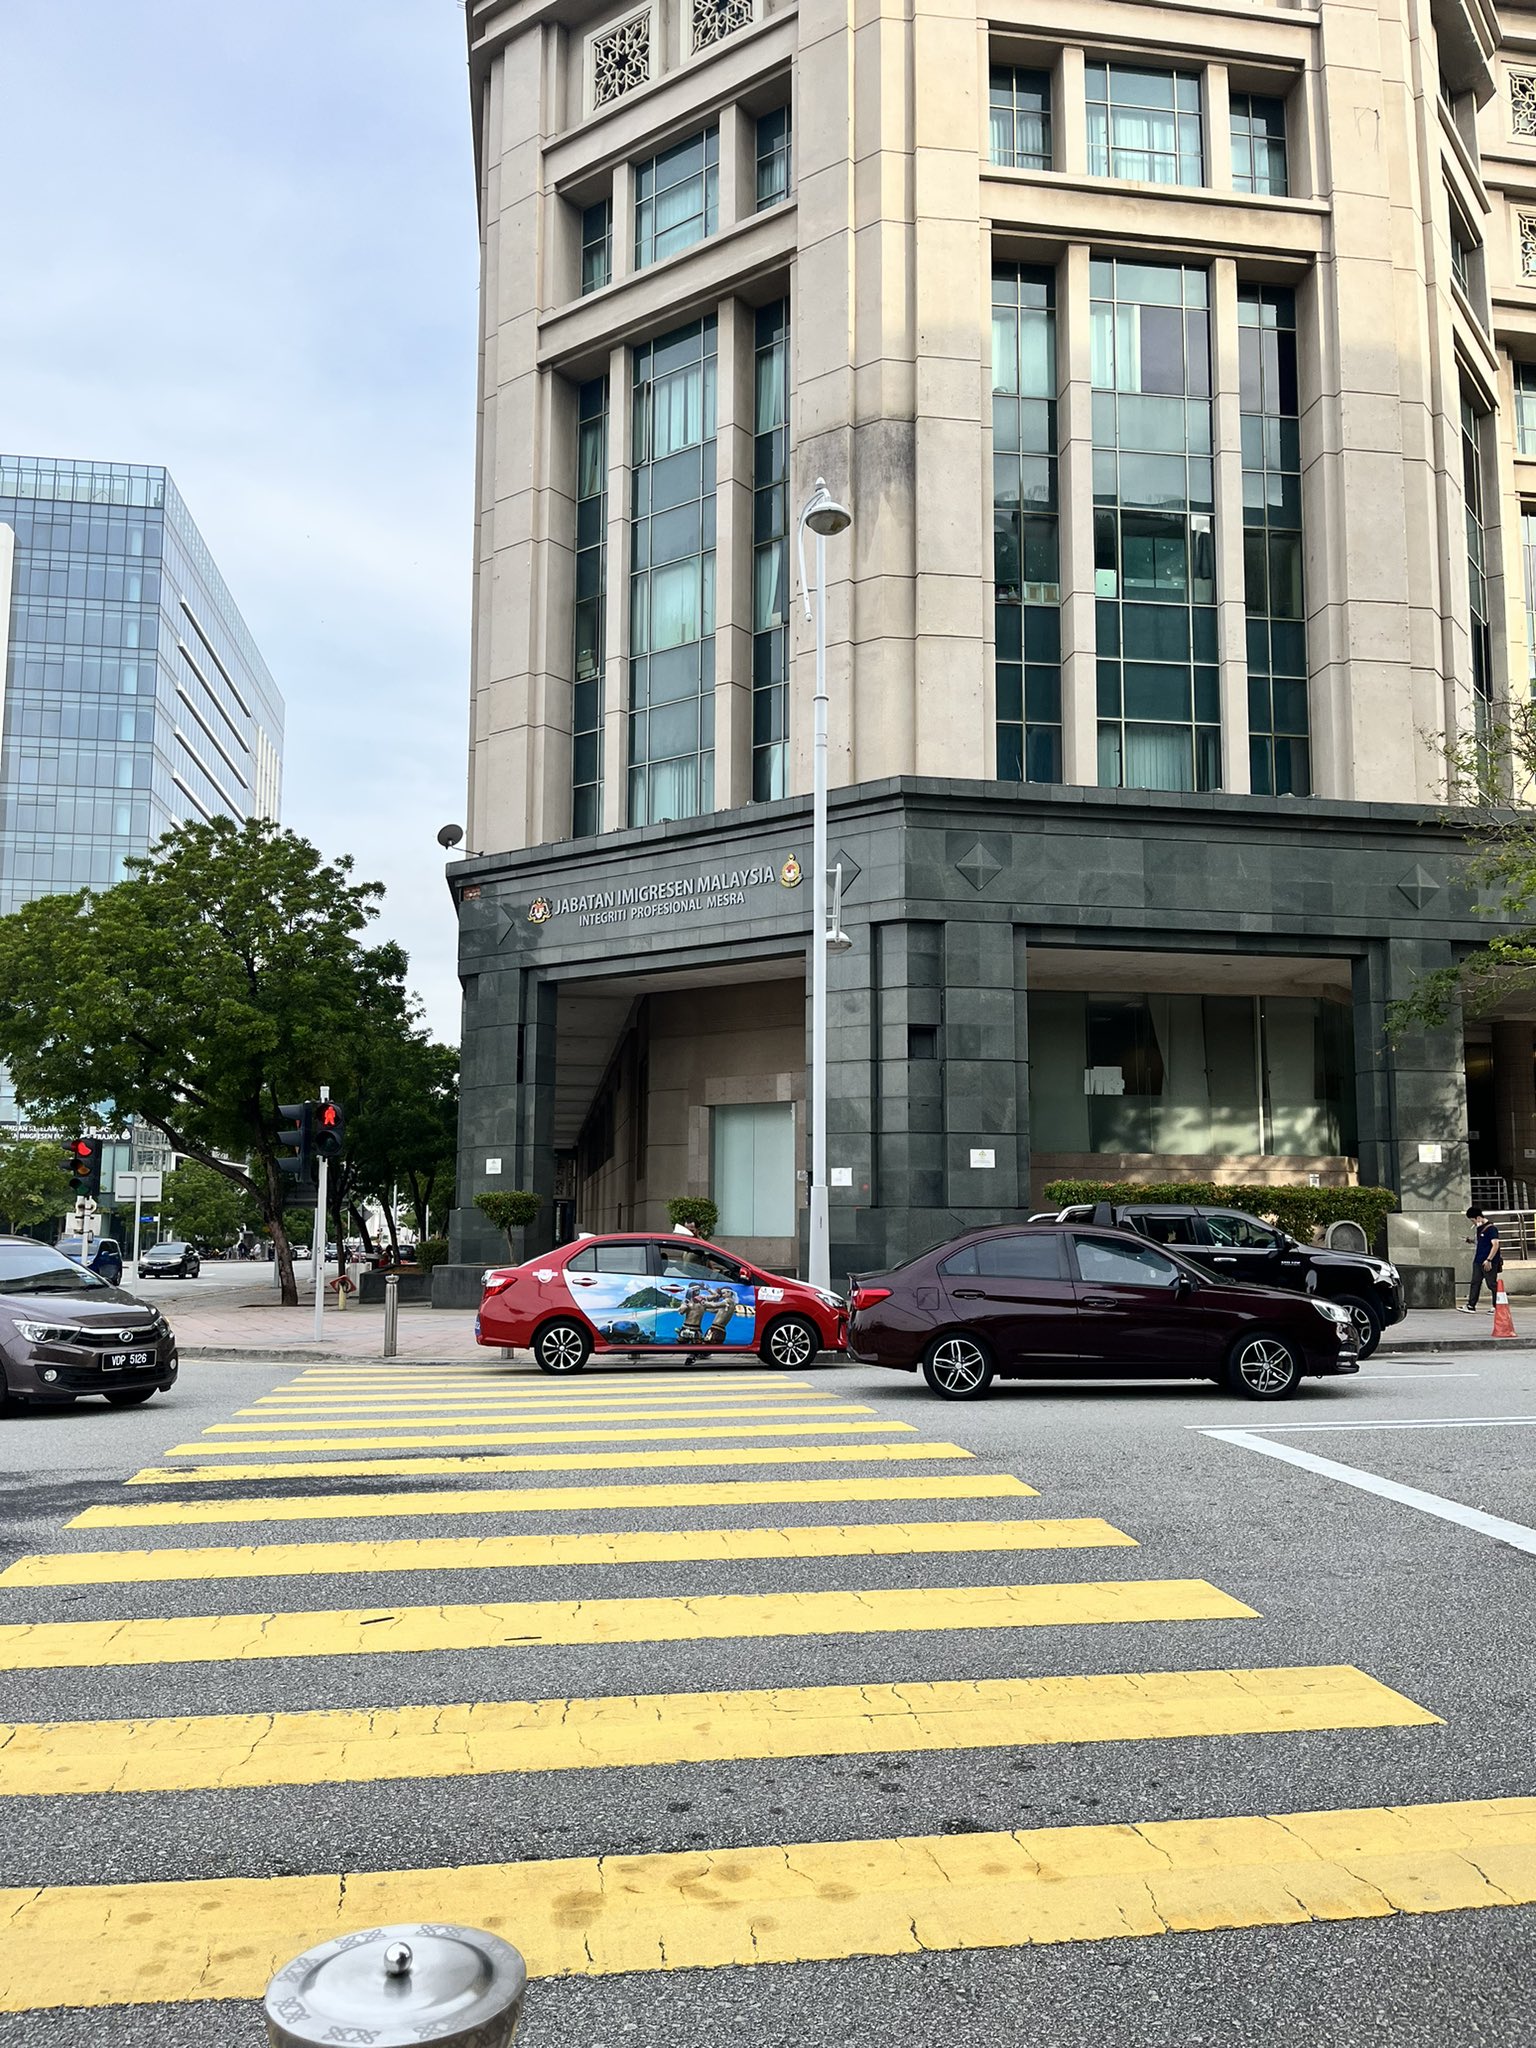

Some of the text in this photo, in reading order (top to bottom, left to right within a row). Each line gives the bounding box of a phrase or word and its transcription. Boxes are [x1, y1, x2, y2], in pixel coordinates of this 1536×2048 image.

[555, 866, 775, 915] JABATAN IMIGRESEN MALAYSIA
[580, 891, 745, 927] INTEGRITI PROFESIONAL MESRA
[112, 1353, 147, 1366] VDP 5126
